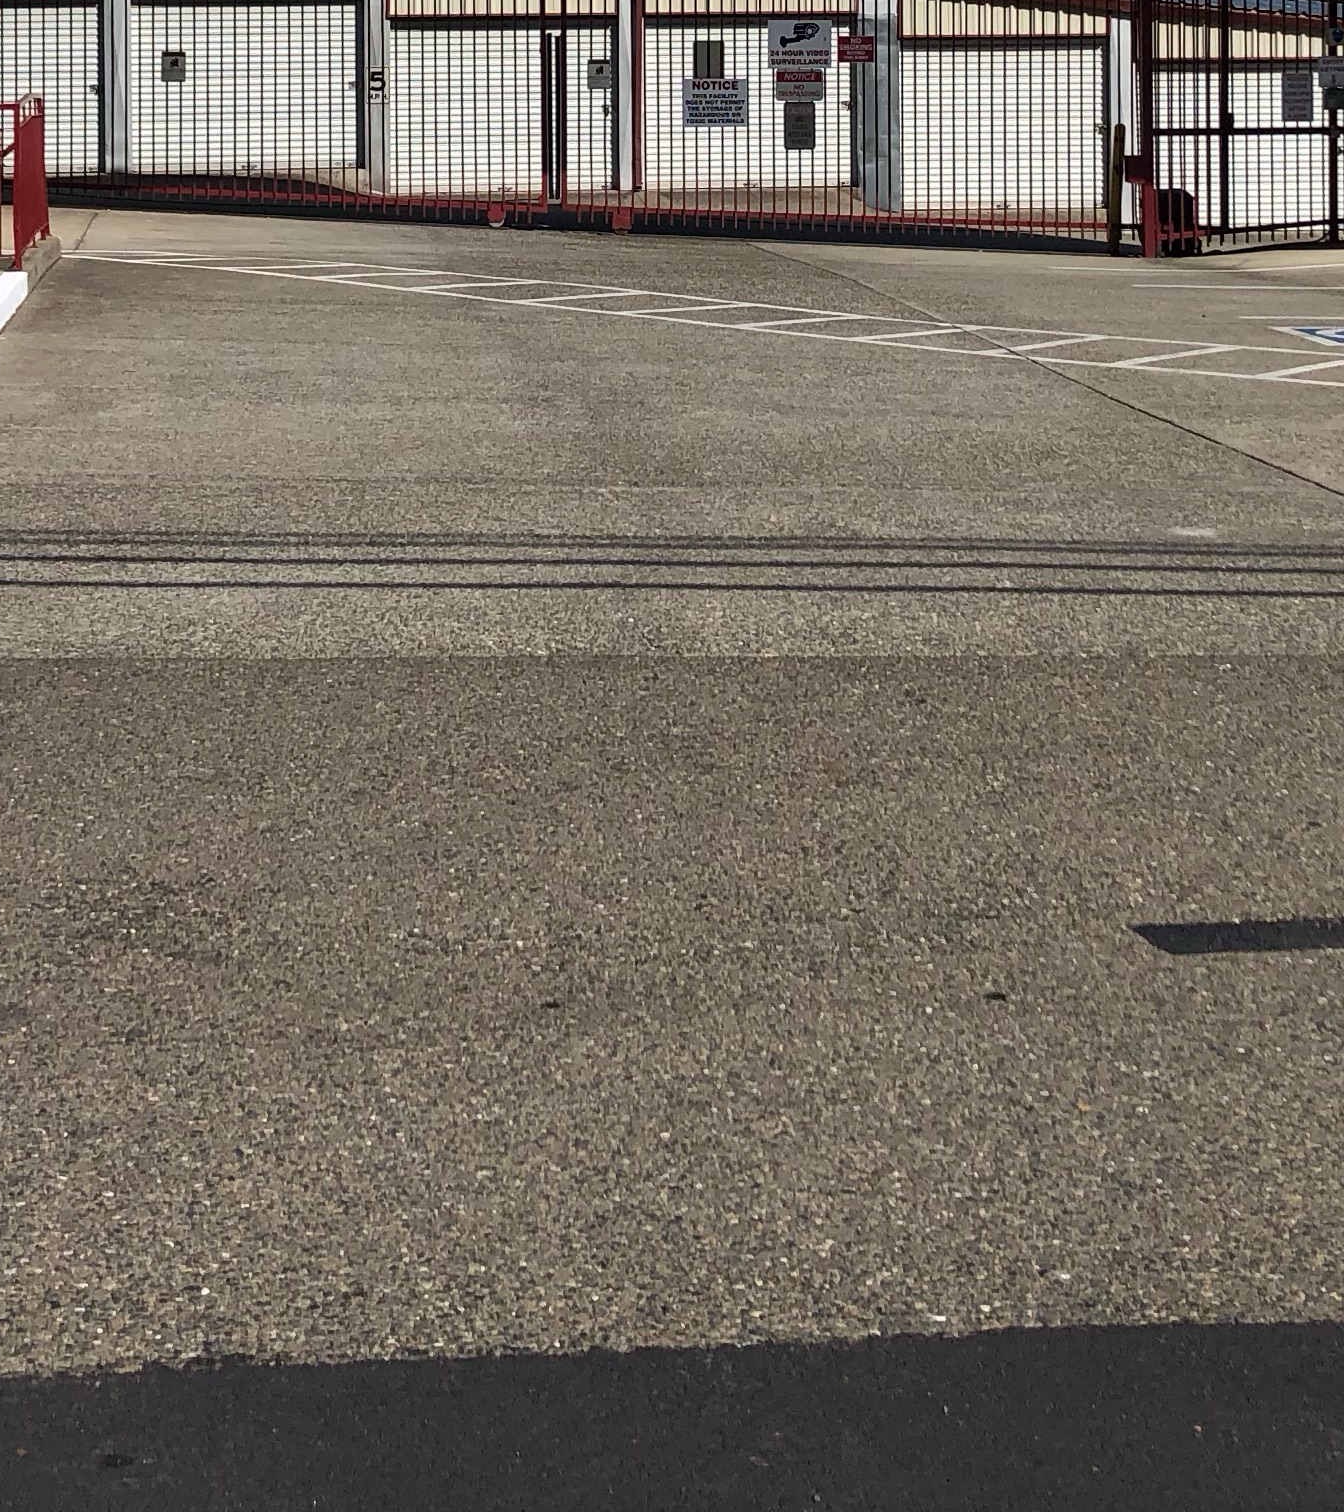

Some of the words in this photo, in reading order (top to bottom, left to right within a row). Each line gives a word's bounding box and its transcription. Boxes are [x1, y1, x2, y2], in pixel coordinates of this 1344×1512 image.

[771, 58, 829, 66] SURVEILLANCE
[783, 72, 816, 81] NOTICE
[691, 80, 739, 91] NOTICE
